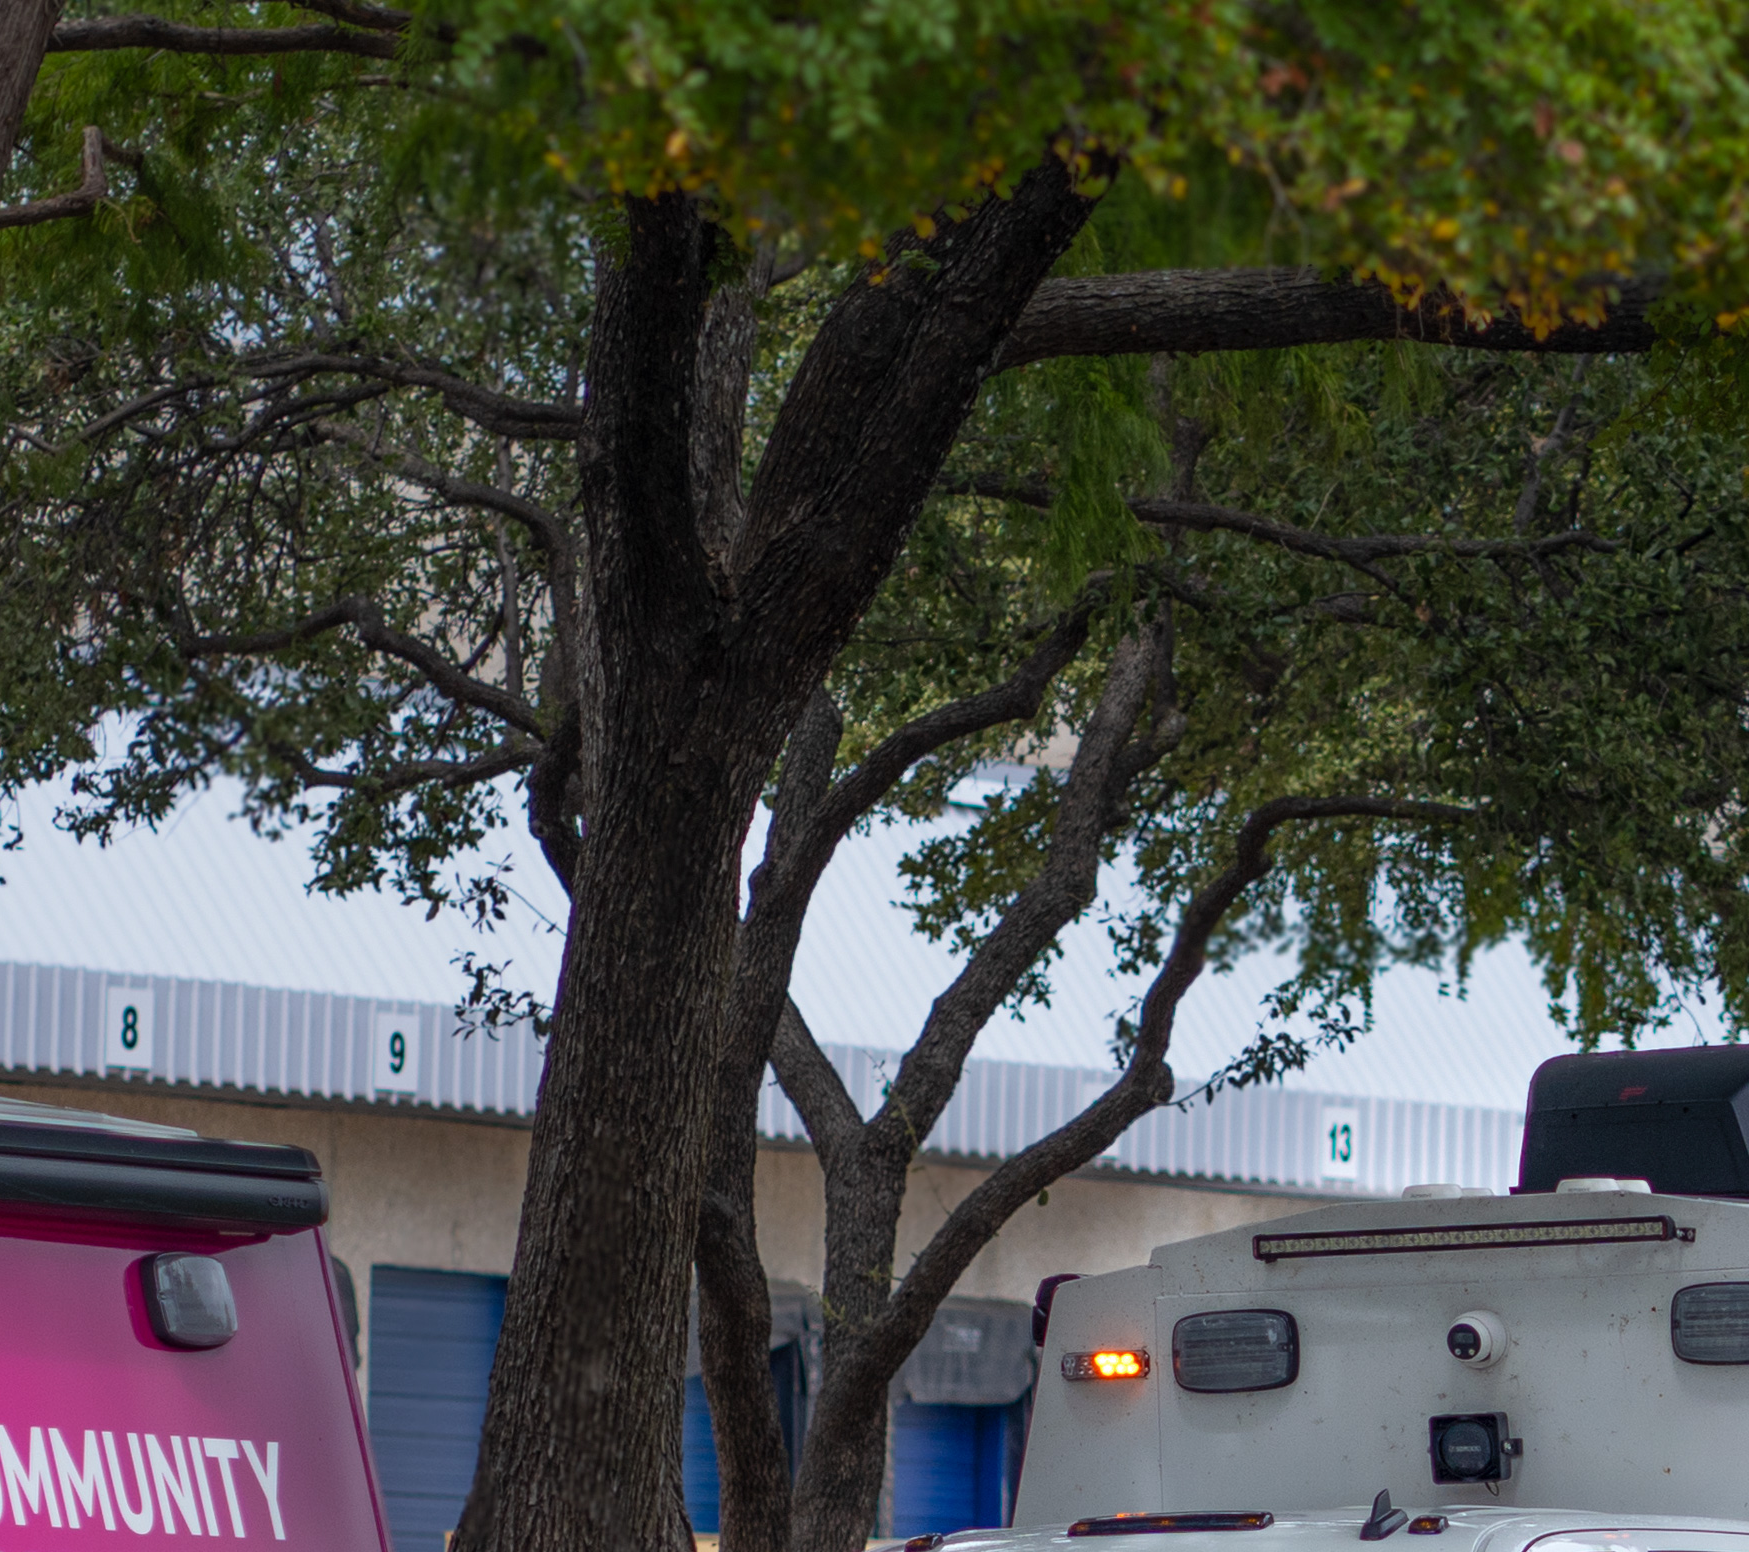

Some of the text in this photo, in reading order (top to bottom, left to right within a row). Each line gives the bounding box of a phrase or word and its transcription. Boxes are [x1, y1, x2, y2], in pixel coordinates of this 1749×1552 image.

[122, 1006, 139, 1050] 8
[389, 1032, 406, 1074] 9
[1329, 1123, 1351, 1163] 13
